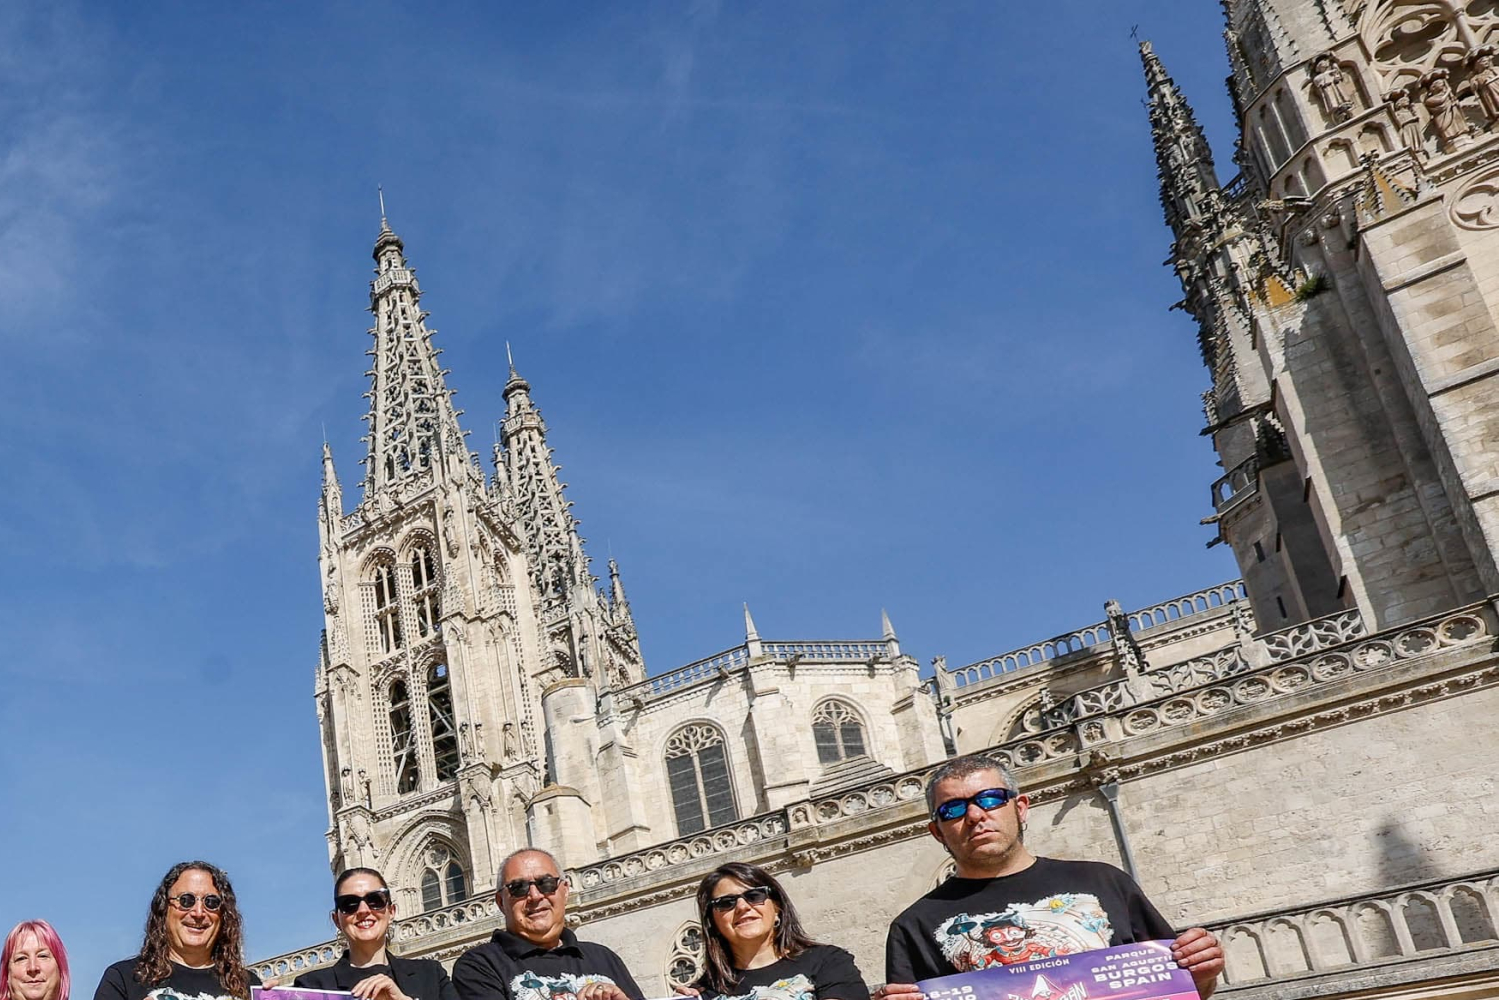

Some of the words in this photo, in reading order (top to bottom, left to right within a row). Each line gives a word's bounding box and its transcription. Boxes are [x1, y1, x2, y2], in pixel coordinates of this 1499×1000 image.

[1105, 948, 1156, 961] PARQUE
[1009, 966, 1026, 974] VIII
[1030, 958, 1070, 971] EDICIÓN
[1091, 964, 1117, 973] SAN
[1093, 961, 1178, 983] BURGOS
[1109, 972, 1172, 989] SPAIN
